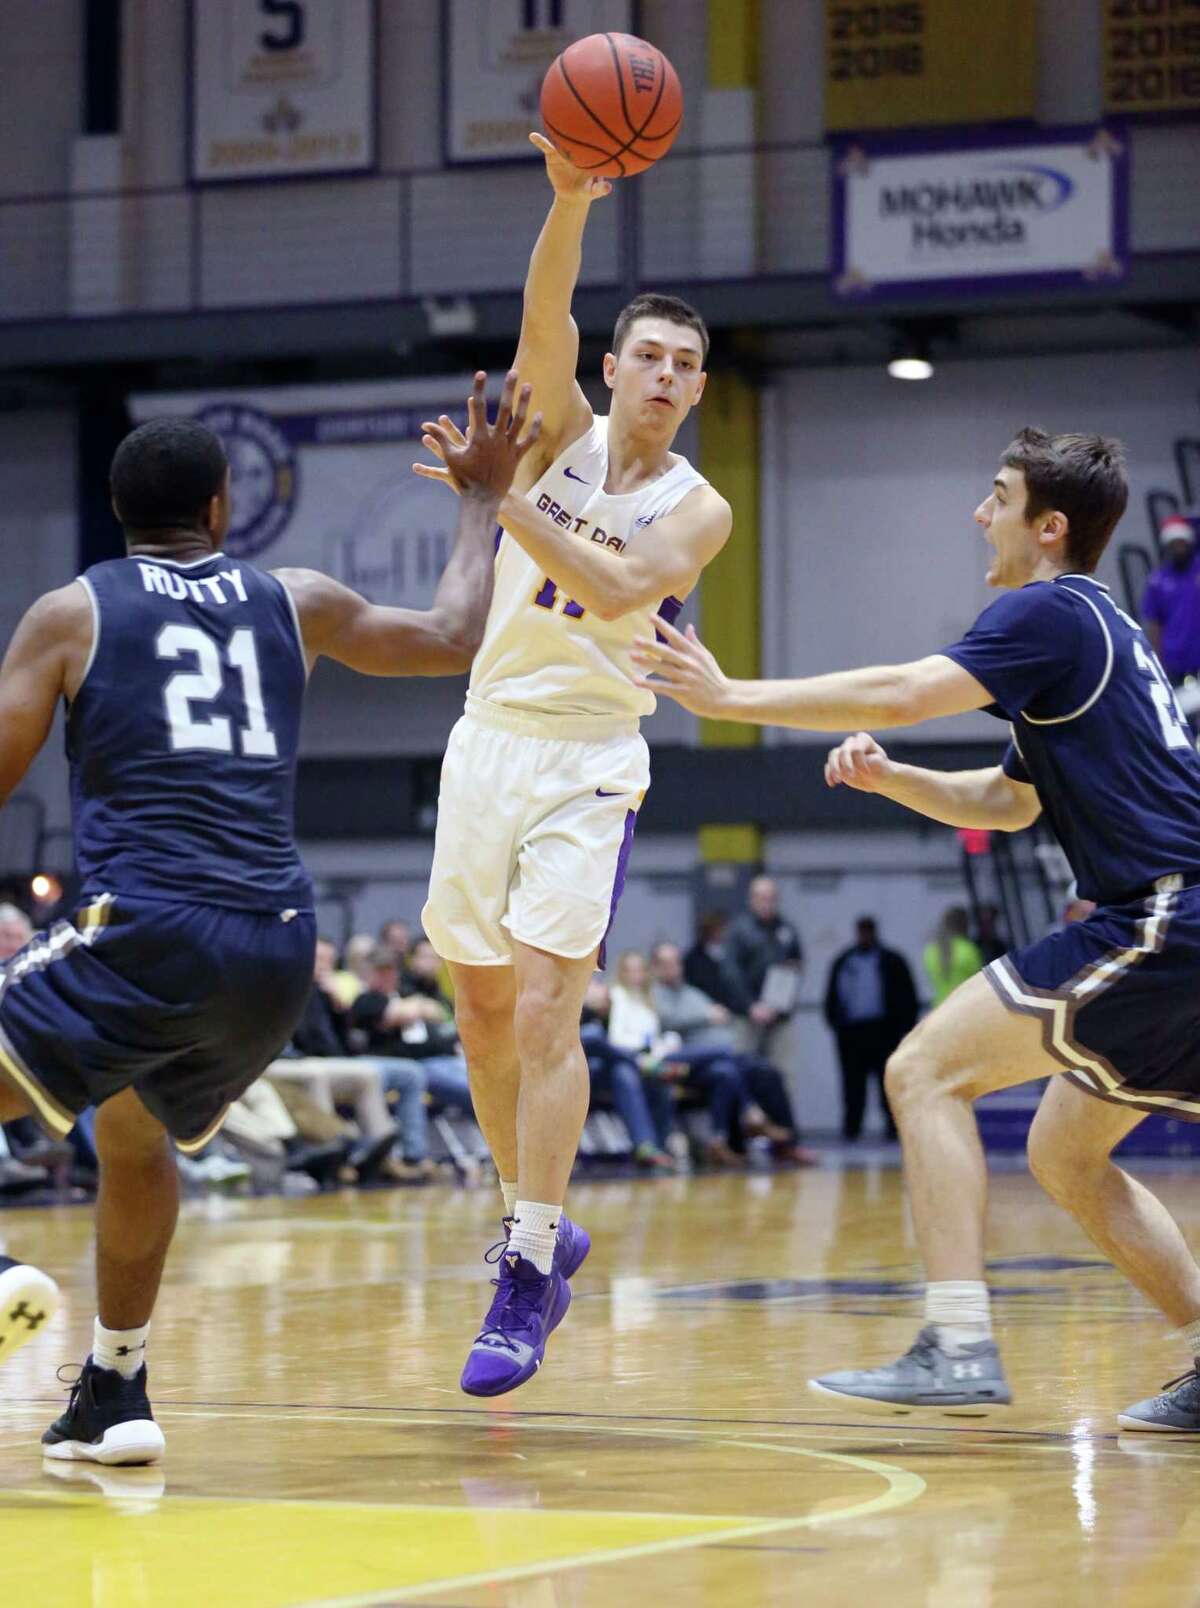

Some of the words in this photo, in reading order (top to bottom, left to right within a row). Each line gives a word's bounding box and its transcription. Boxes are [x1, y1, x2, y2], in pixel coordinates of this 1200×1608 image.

[879, 177, 1044, 219] MOHAWK
[910, 213, 1026, 250] Honda
[535, 492, 589, 534] GRET
[155, 620, 279, 758] 21
